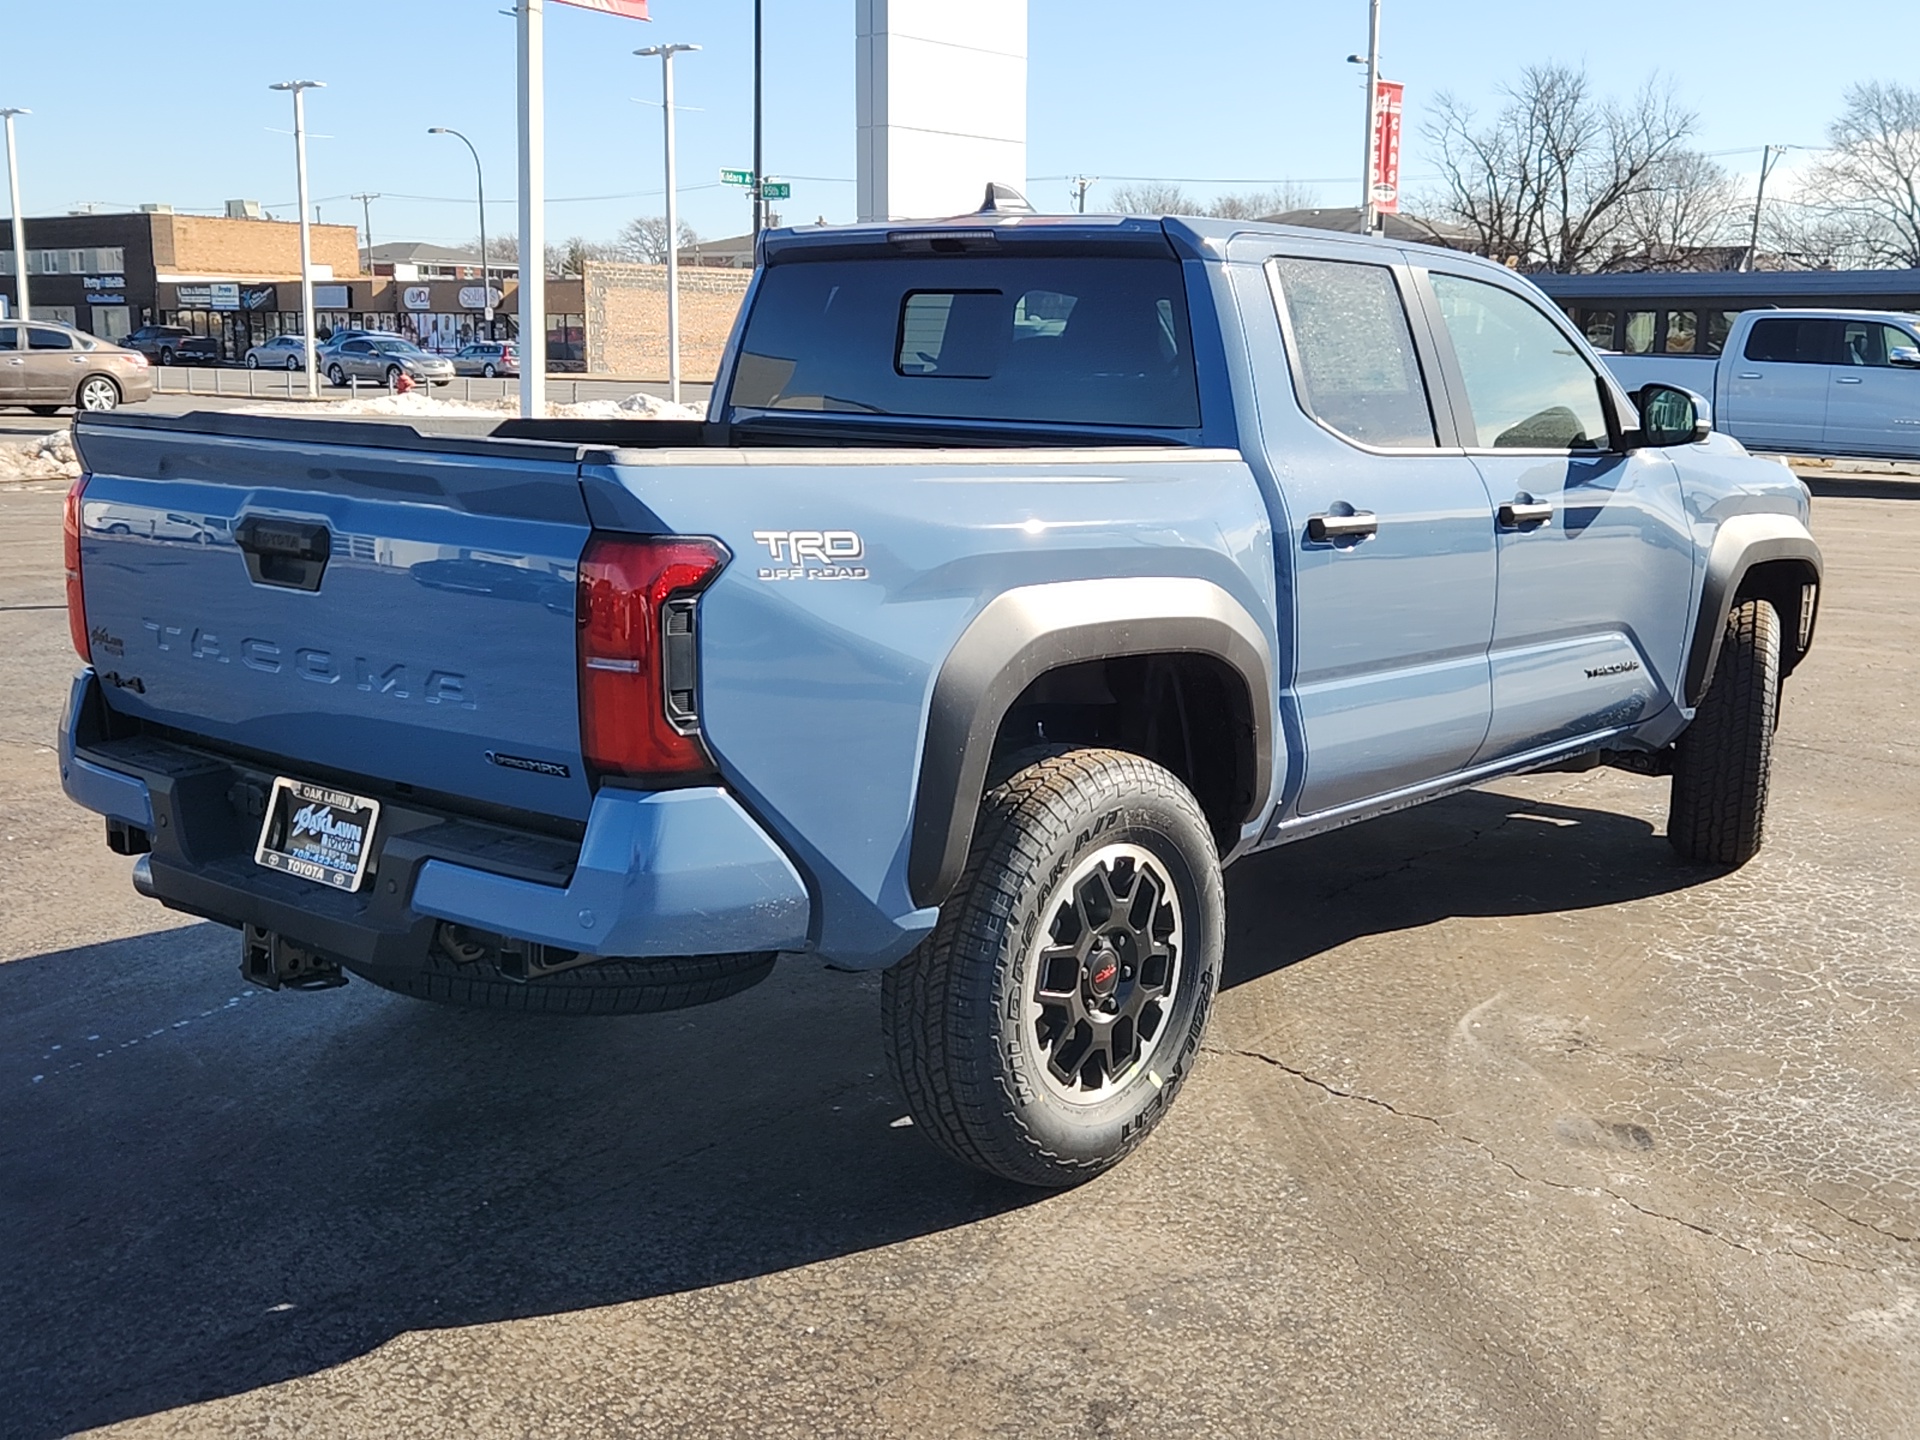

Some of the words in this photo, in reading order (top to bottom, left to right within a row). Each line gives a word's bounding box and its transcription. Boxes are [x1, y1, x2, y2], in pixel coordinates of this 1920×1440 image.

[1388, 116, 1399, 183] CARS
[764, 185, 779, 197] 95th
[780, 185, 789, 197] St
[752, 530, 864, 567] TRD
[757, 566, 804, 581] OFF
[806, 566, 870, 581] ROAD
[142, 617, 476, 710] TACOMA
[1583, 660, 1640, 679] TACOMA
[303, 786, 324, 802] OAK
[324, 791, 352, 808] LAWN
[326, 836, 356, 854] TOYOTA
[287, 859, 325, 880] TOYOTA
[292, 848, 358, 872] 708-423-5200
